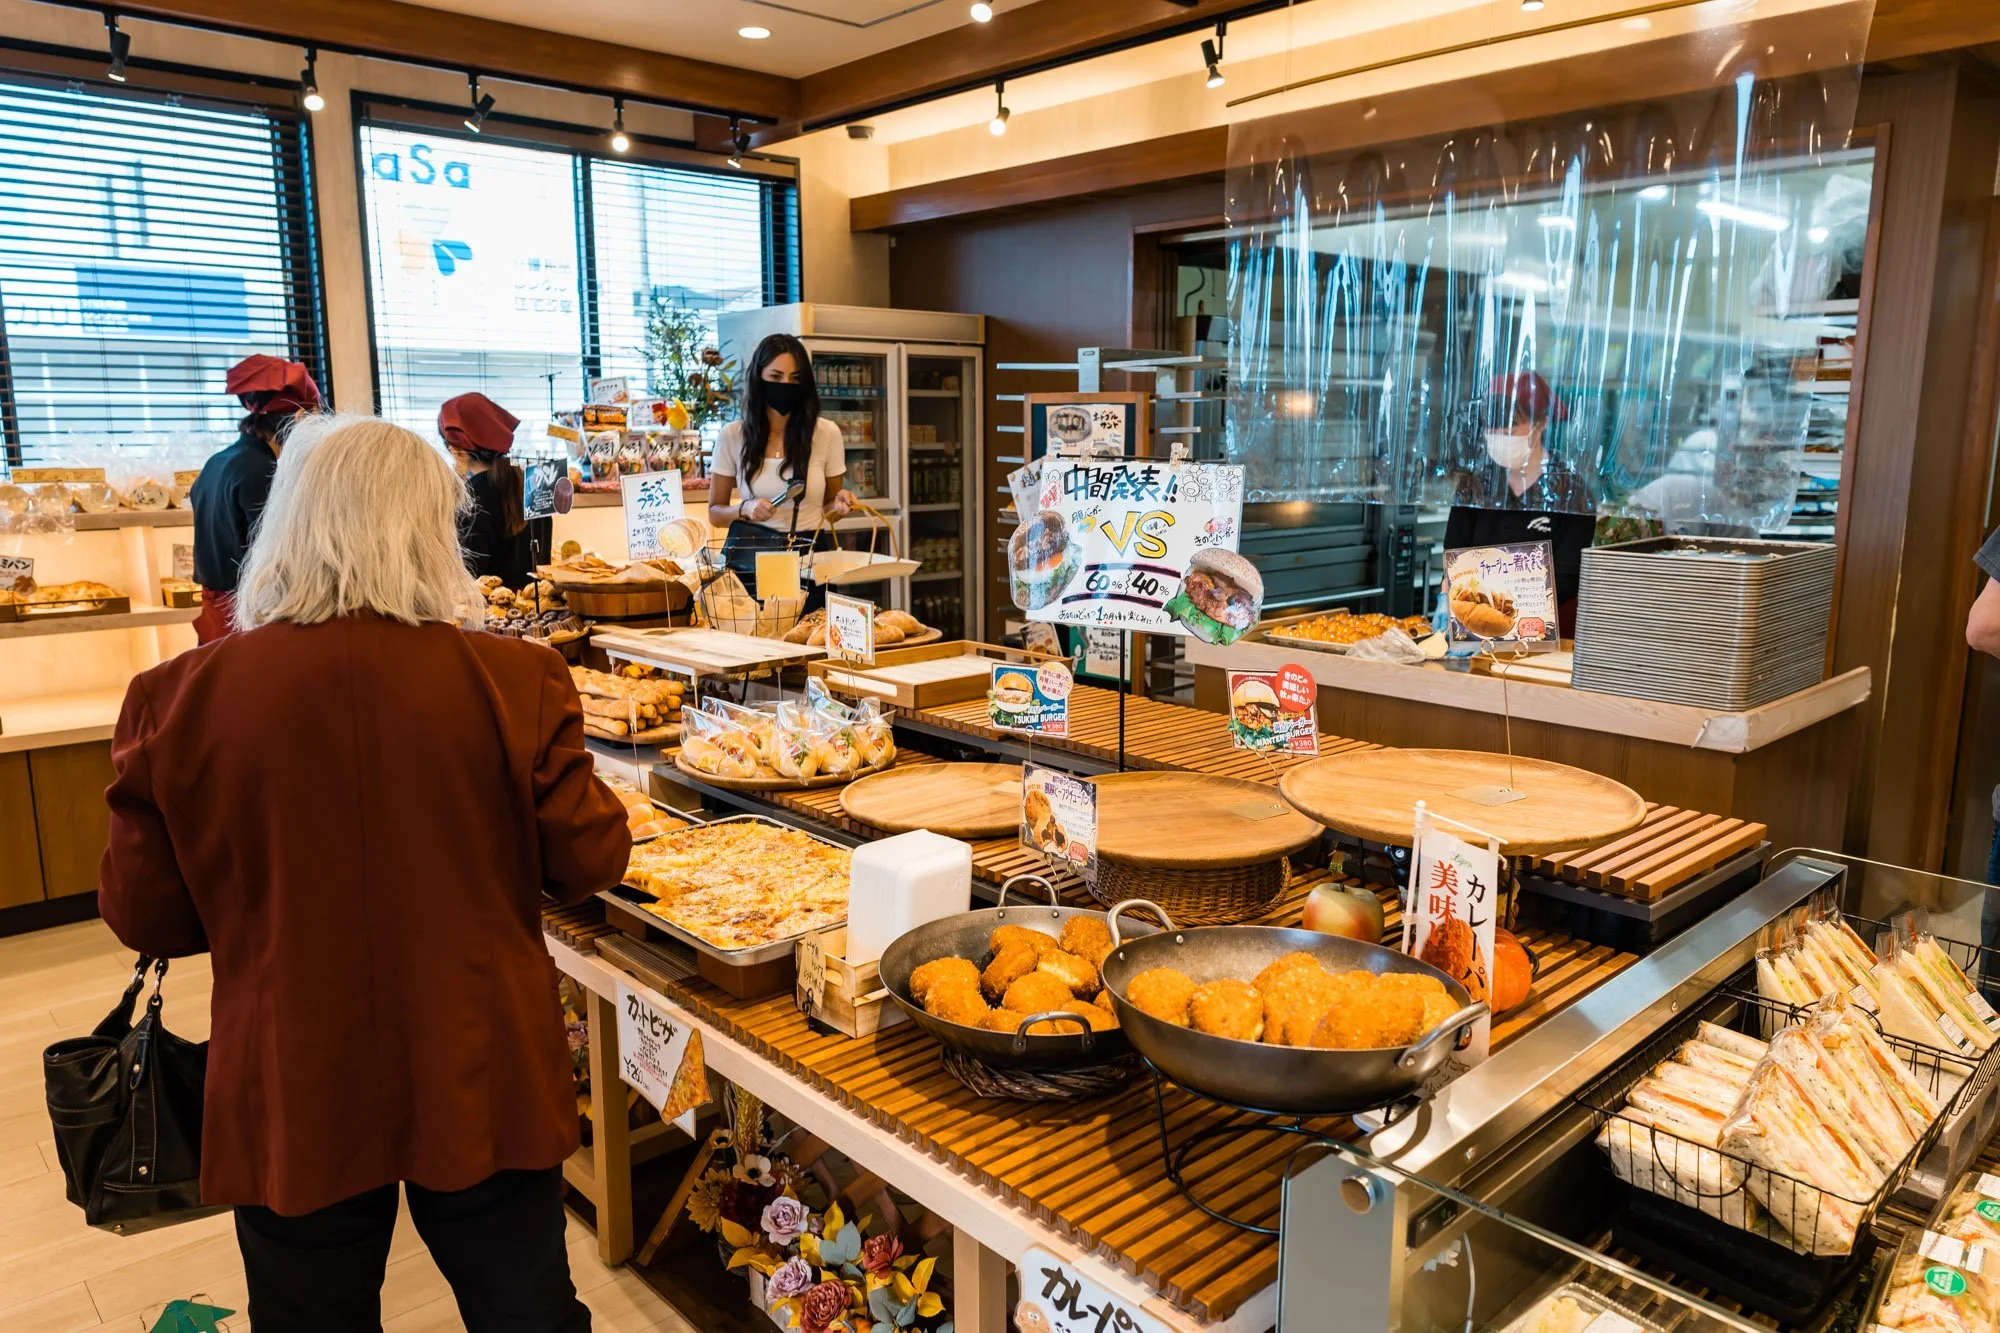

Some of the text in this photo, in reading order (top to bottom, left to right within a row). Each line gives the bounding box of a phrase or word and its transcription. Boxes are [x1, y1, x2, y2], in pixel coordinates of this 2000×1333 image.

[363, 143, 470, 189] aSa
[640, 477, 666, 496] チーズ
[637, 492, 671, 511] フランス
[1100, 509, 1176, 559] VS
[1013, 712, 1067, 724] TSUKIMI BURGER
[1285, 728, 1316, 741] BURGER
[626, 993, 679, 1046] カットピザ
